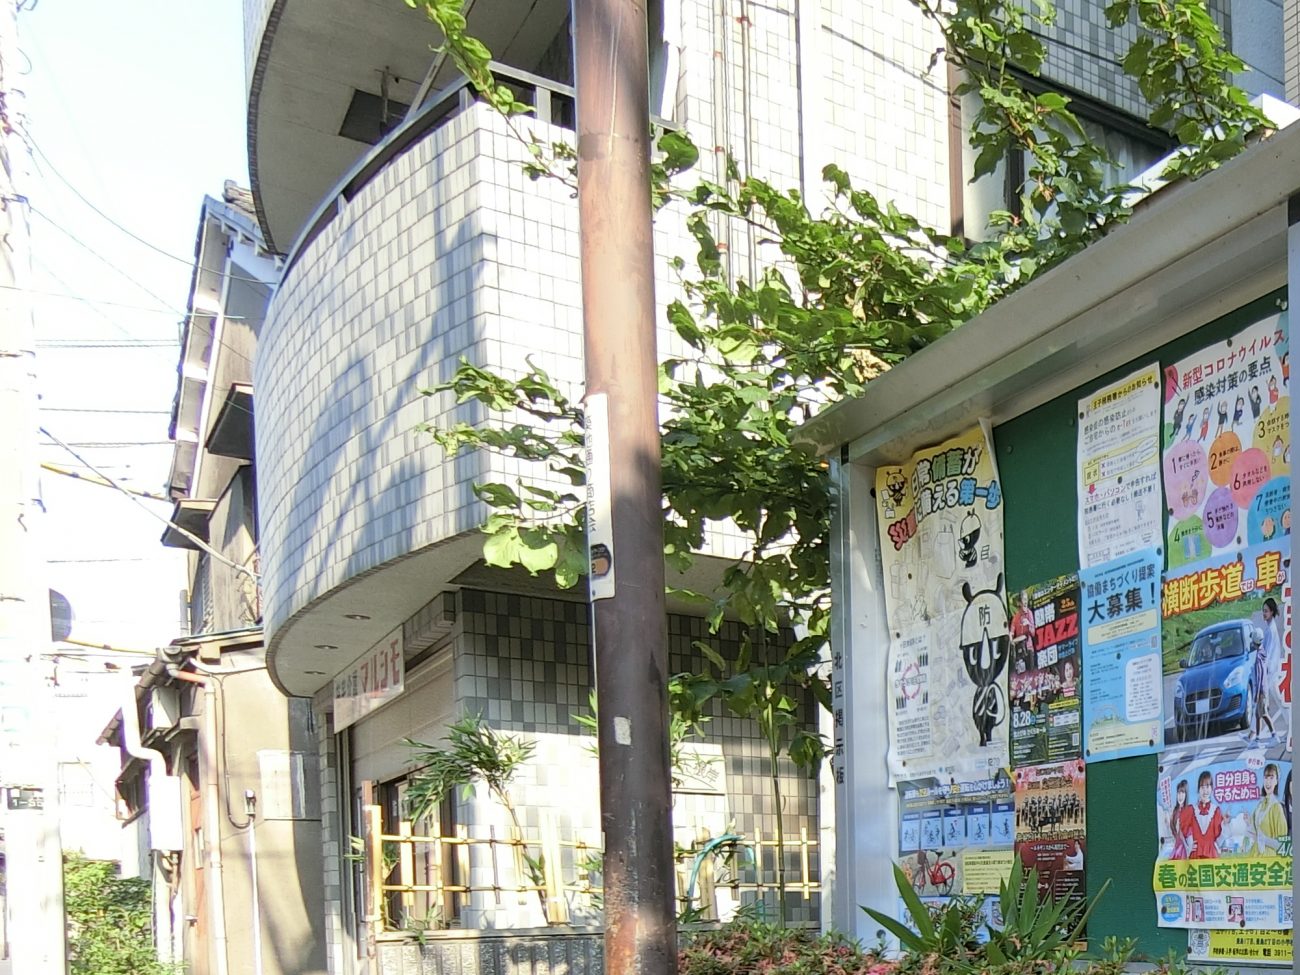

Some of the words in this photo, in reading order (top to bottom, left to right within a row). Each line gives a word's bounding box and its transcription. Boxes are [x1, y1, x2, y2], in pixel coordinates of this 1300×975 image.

[1182, 329, 1285, 390] 新型コロナウイルス
[1194, 356, 1272, 405] 感染対策の要点
[1258, 421, 1266, 438] 3
[1210, 453, 1217, 470] 2
[1234, 473, 1240, 490] 6
[1256, 494, 1263, 512] 7
[1207, 512, 1215, 529] 5
[1174, 528, 1180, 543] 4
[1087, 564, 1156, 598] 協働まちづくり提案
[979, 604, 991, 626] 防
[1036, 612, 1079, 651] JAZZ
[1013, 710, 1031, 728] 8.28
[1216, 769, 1256, 787] 自分自身を
